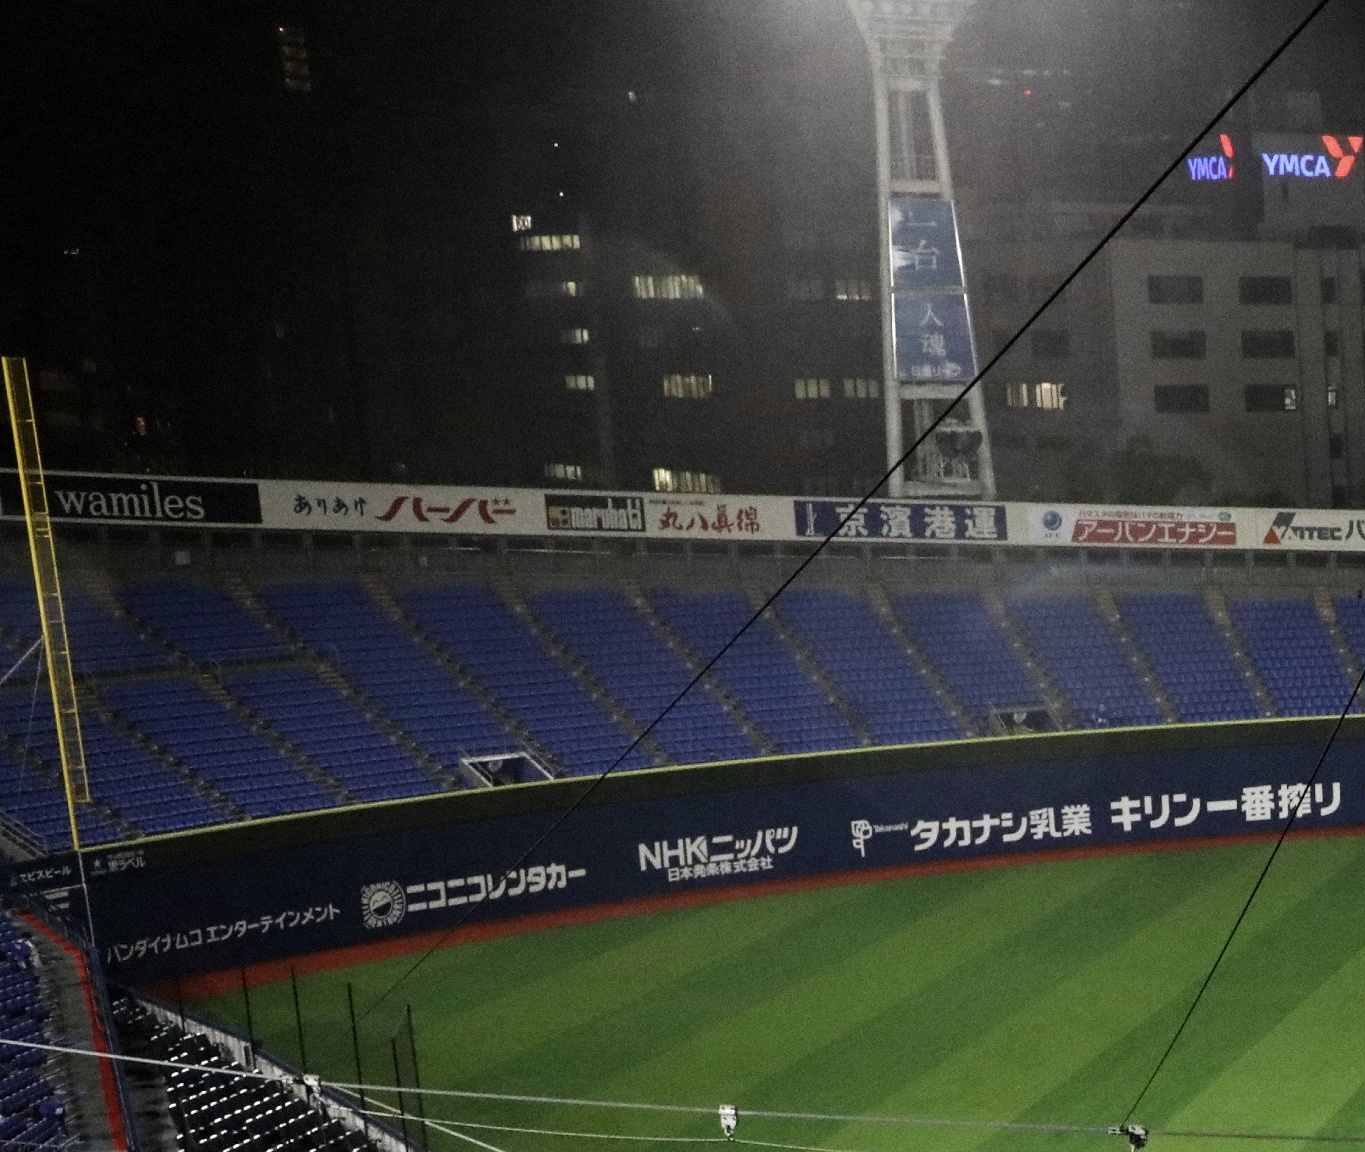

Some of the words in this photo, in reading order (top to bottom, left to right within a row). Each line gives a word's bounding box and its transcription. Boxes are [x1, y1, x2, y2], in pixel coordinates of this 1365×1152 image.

[1188, 156, 1228, 180] YMCA
[1262, 153, 1331, 178] YMCA
[55, 481, 205, 519] wamiles
[293, 494, 365, 517] ありあけ
[375, 496, 517, 523] ハーバー
[1077, 521, 1234, 543] アーバンエナジー
[1110, 782, 1341, 832] キリン一番搾り
[911, 803, 1092, 851] タカナシ乳業
[407, 863, 586, 912] ニコニコレンタカー
